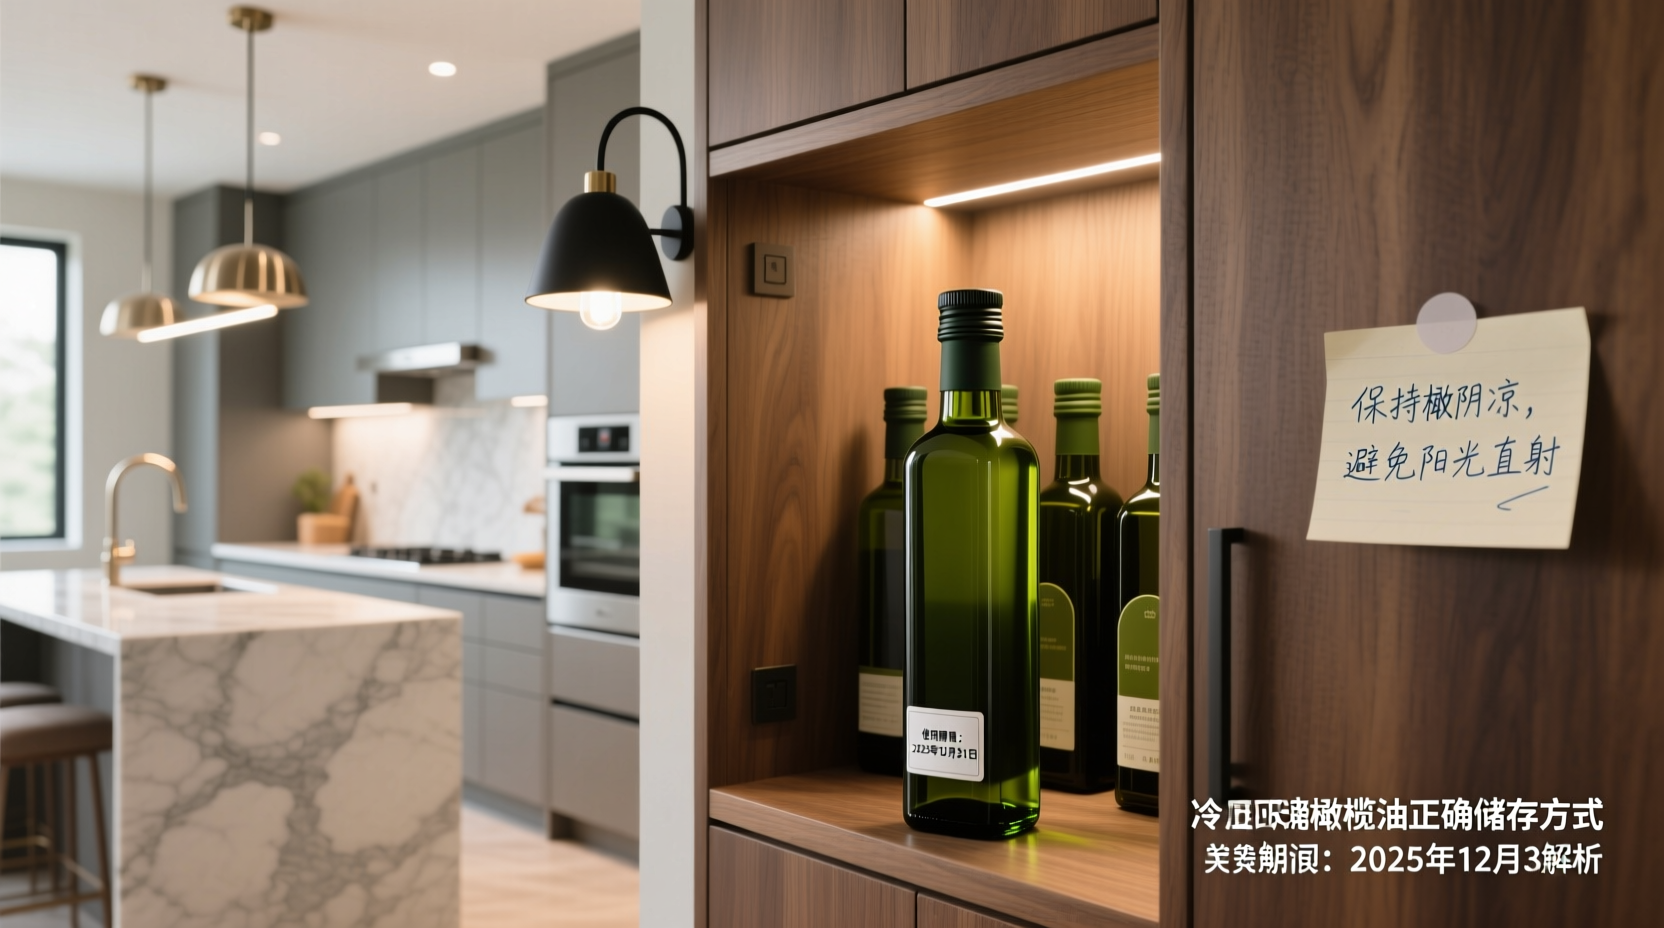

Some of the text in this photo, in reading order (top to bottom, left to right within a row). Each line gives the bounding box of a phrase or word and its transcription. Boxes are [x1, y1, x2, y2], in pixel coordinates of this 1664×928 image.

[1343, 434, 1561, 482] 避免阳光直射
